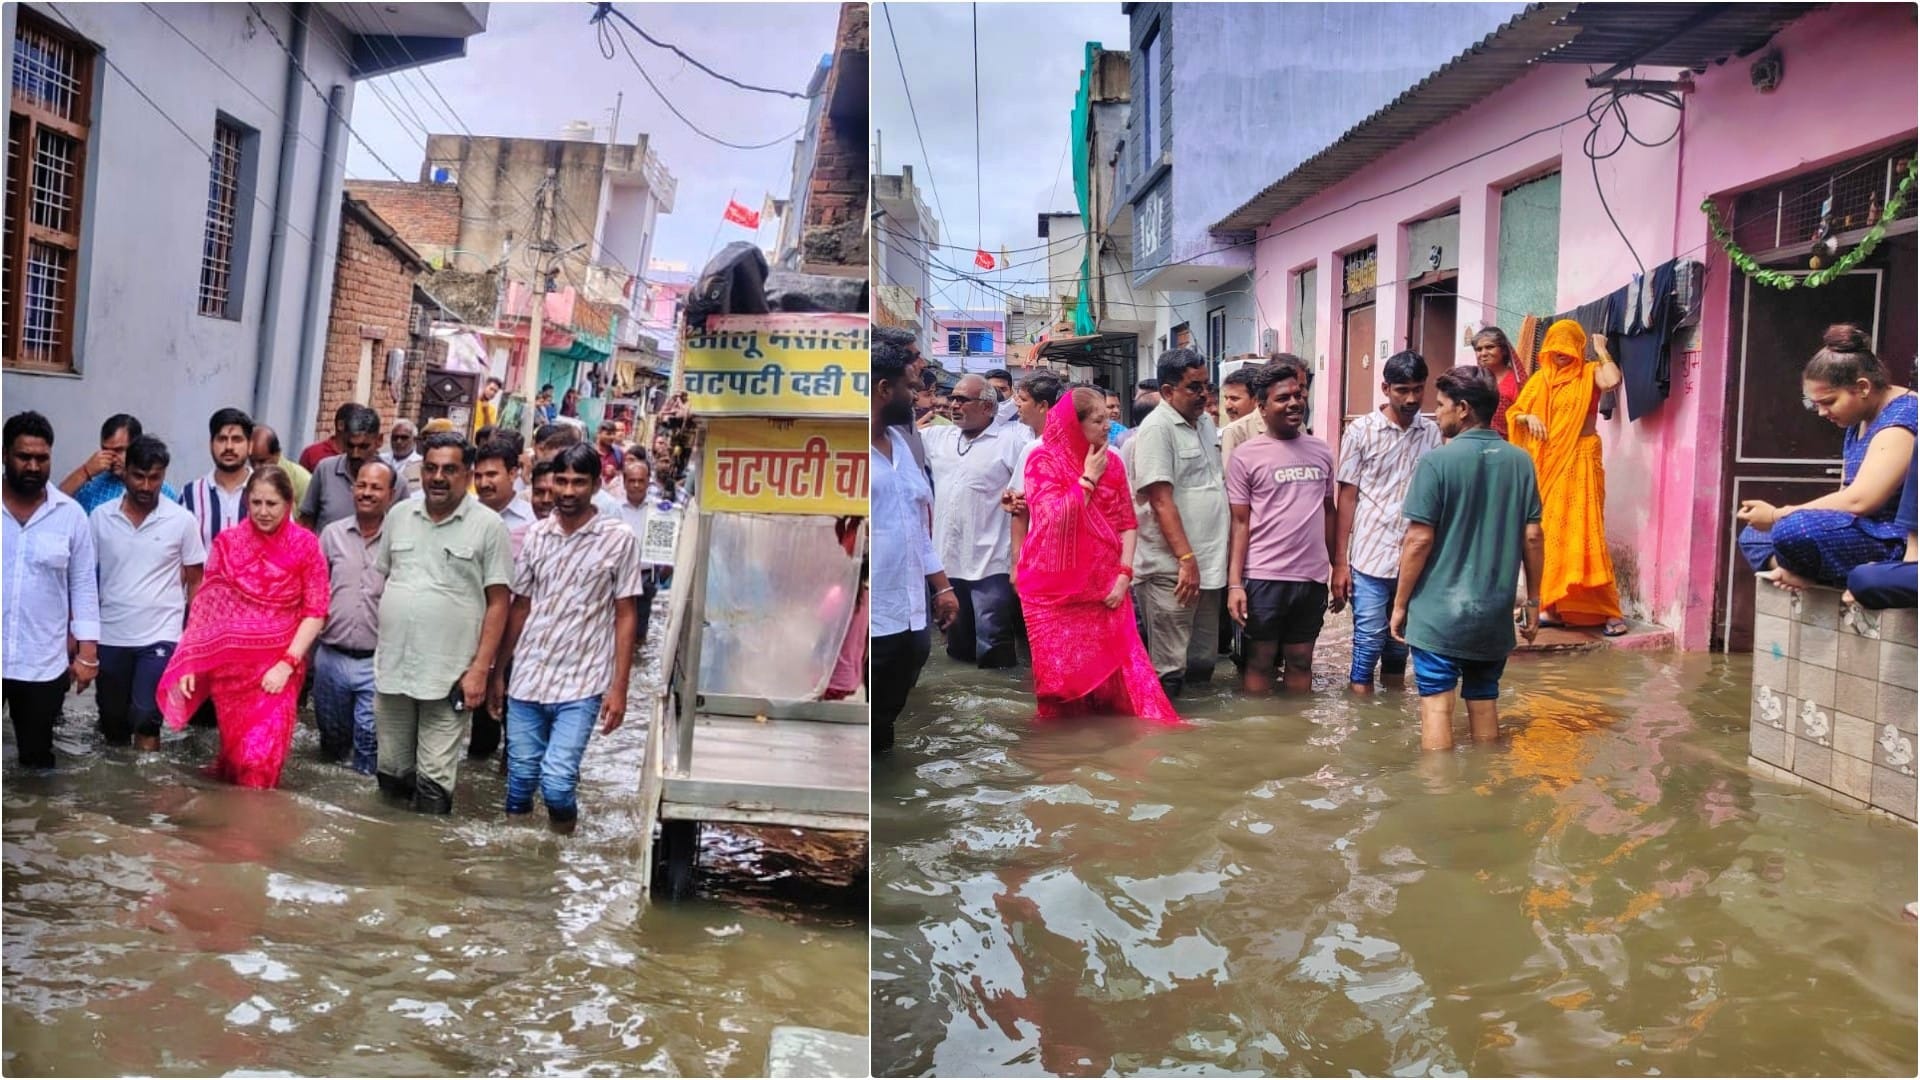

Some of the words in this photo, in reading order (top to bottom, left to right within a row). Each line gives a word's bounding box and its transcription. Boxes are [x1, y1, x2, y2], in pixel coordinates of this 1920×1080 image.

[684, 364, 784, 396] चटपटी
[790, 365, 846, 396] दही
[717, 437, 831, 498] चटपटी
[1274, 466, 1321, 484] GREAT
